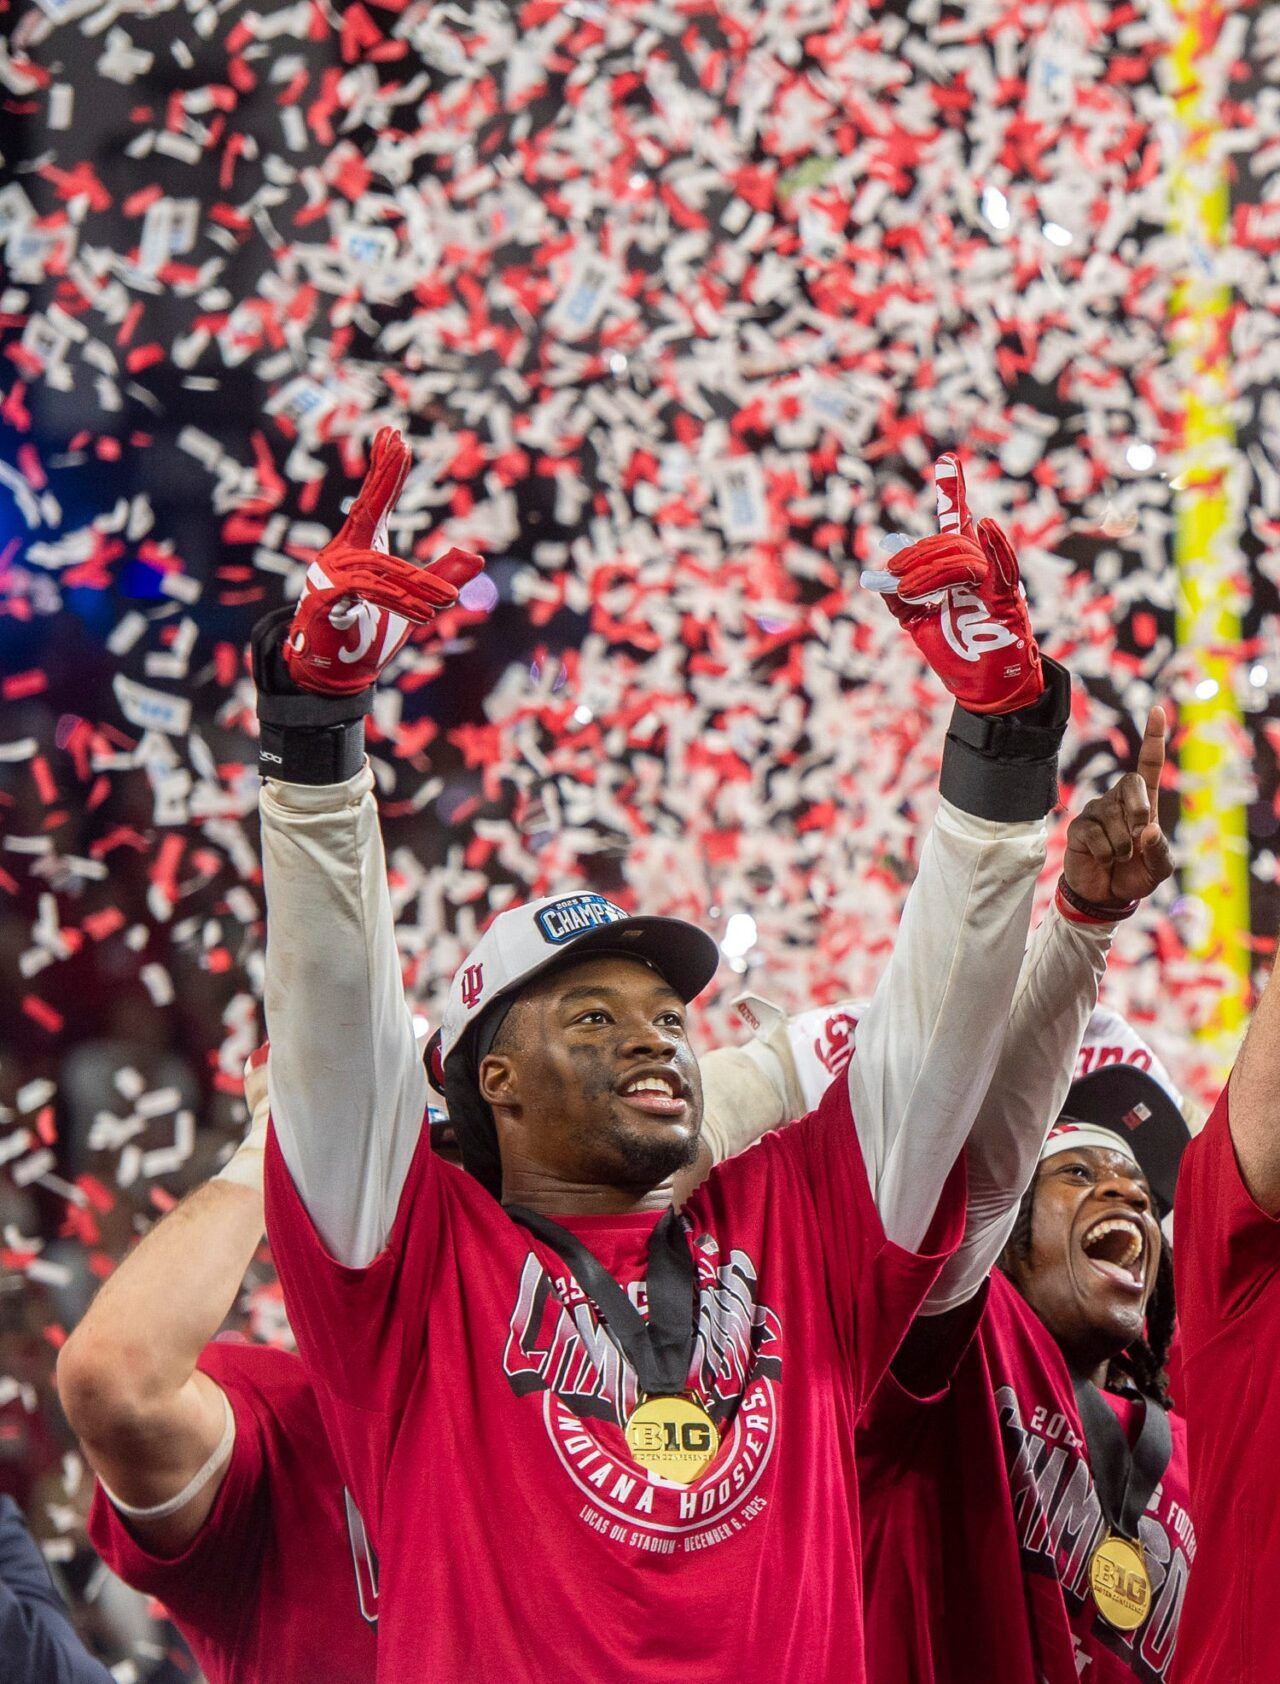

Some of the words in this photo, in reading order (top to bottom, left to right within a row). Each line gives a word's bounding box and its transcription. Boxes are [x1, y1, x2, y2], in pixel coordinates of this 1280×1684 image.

[579, 1504, 610, 1535] LUCAS
[610, 1525, 626, 1543] OIL
[629, 1532, 676, 1554] STADIUM
[684, 1524, 734, 1552] DECEMBER
[740, 1495, 768, 1522] 2025
